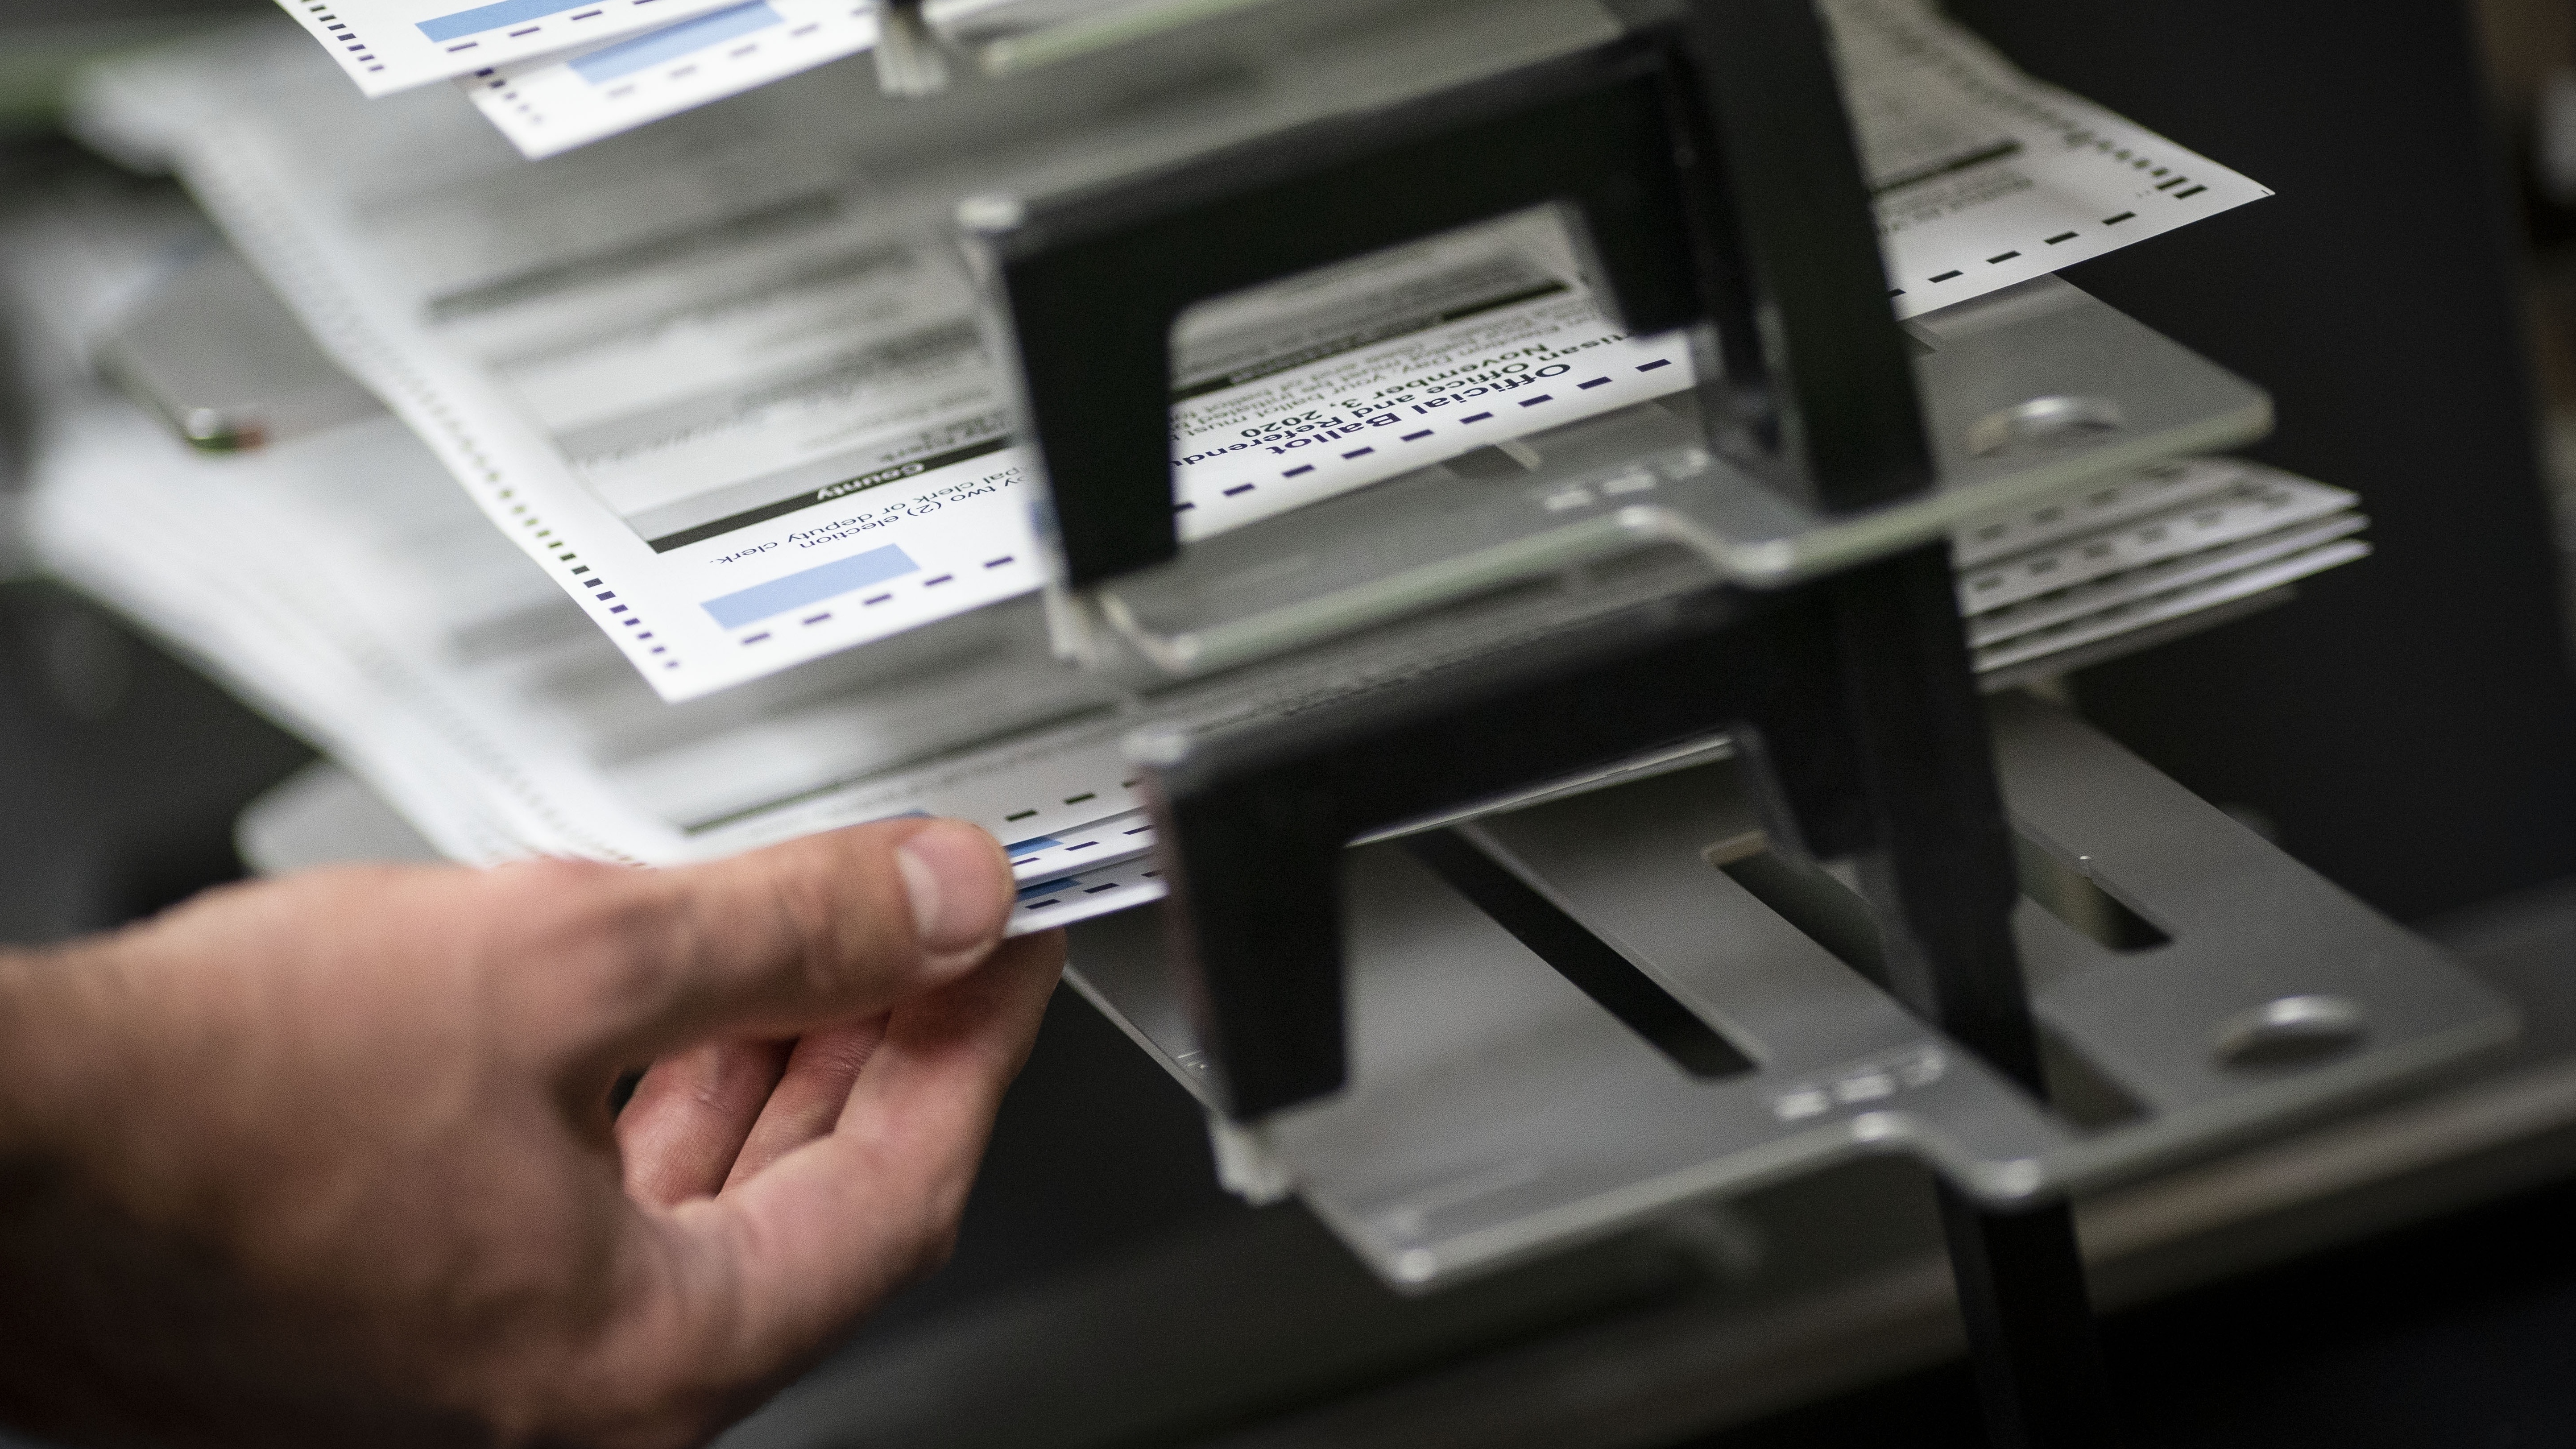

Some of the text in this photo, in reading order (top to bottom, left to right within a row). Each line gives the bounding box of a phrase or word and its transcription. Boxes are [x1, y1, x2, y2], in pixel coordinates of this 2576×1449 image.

[1330, 373, 1384, 394] your
[1427, 363, 1528, 393] Office
[1241, 344, 1548, 437] November 3, 2020
[1256, 393, 1325, 418] ballot
[1268, 364, 1570, 454] Official Ballot
[1352, 395, 1413, 418] and
[1187, 416, 1247, 436] must
[816, 461, 925, 501] County
[918, 482, 974, 502] clerk
[951, 486, 996, 501] two
[884, 503, 907, 514] or
[906, 501, 942, 518] (2)
[788, 514, 873, 542] deputy
[800, 516, 899, 548] election
[709, 542, 778, 564] clerk.
